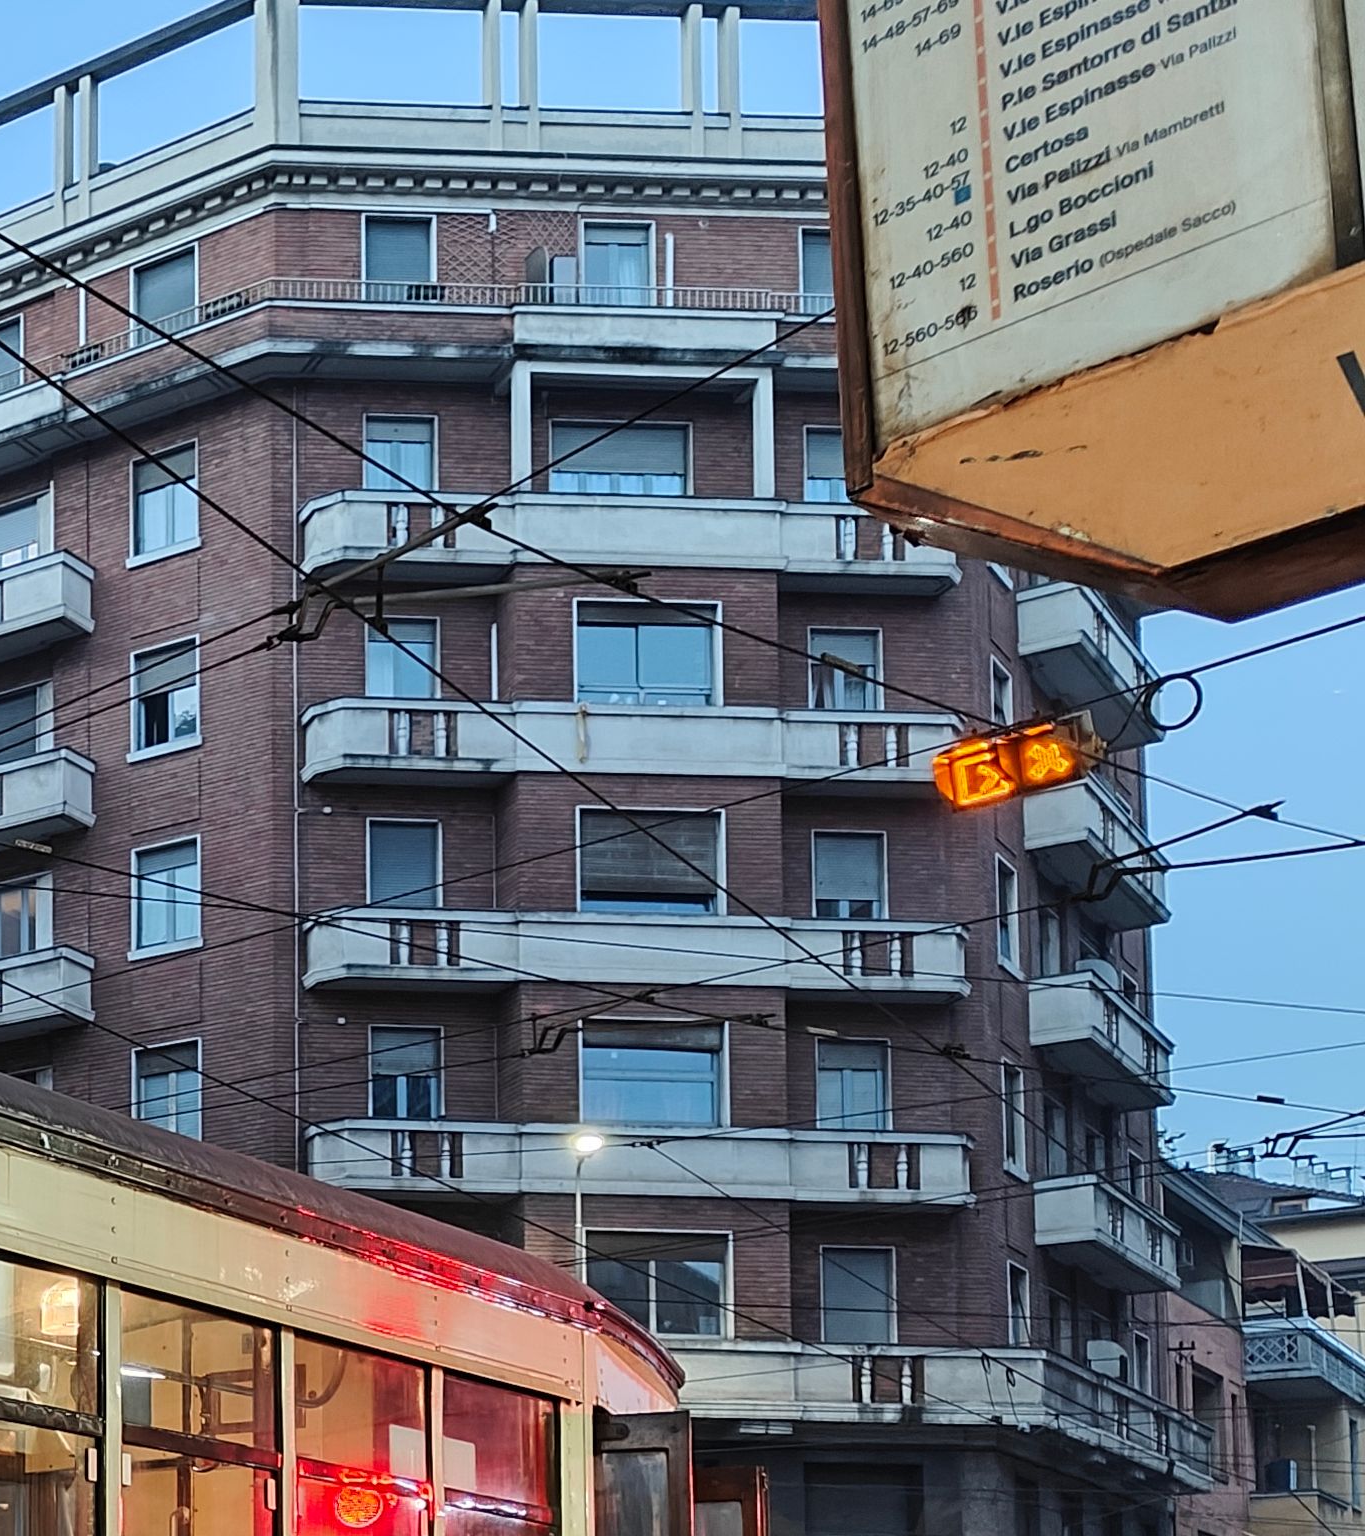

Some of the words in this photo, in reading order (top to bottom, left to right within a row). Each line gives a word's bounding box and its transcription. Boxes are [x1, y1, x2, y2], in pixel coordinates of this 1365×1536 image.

[914, 23, 962, 57] 14-69
[997, 21, 1034, 47] V.le
[999, 52, 1036, 78] V.le
[1001, 83, 1037, 111] P.le
[1042, 38, 1135, 92] Santorre
[1141, 22, 1161, 45] di
[1003, 114, 1040, 141] V.le
[1045, 62, 1156, 123] Espinasse
[1160, 52, 1185, 70] Via
[1189, 26, 1237, 59] Palizzi
[950, 116, 968, 137] 12
[1005, 126, 1089, 174] Certosa
[923, 148, 969, 179] 12-40
[1006, 180, 1039, 205] Via
[1043, 145, 1111, 190] Palizzi
[1116, 140, 1140, 162] Via
[1144, 101, 1226, 153] Mambretti
[872, 170, 971, 227] 12-35-40-57
[1009, 208, 1054, 239] L.go
[1059, 161, 1154, 216] Boccioni
[926, 210, 973, 242] 12-40
[1010, 242, 1043, 269] Via
[1048, 210, 1117, 253] Grassi
[889, 242, 974, 290] 12-40-560
[1013, 257, 1095, 303] Roserio
[1099, 224, 1178, 269] (Ospedale
[1181, 199, 1237, 233] Sacco)
[958, 273, 977, 291] 12
